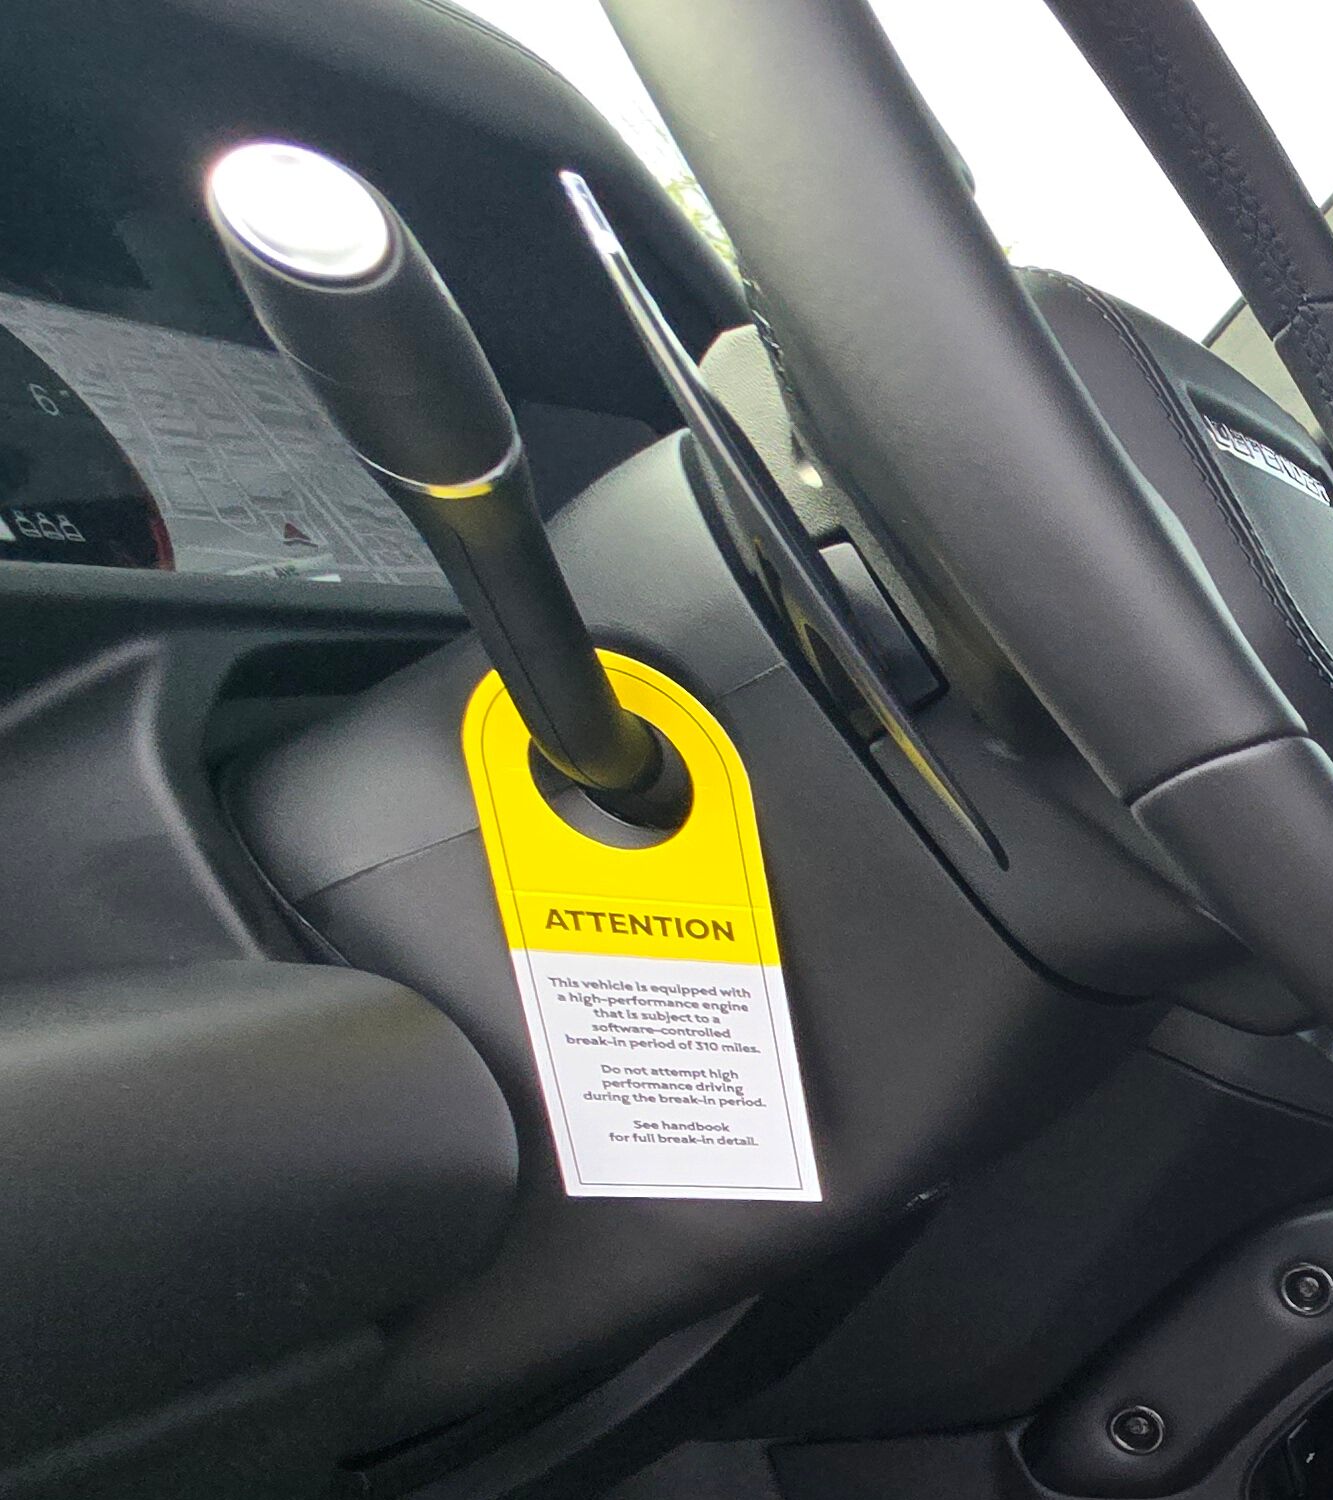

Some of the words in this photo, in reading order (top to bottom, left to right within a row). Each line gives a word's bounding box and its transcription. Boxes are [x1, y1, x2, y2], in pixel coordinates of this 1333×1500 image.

[28, 383, 60, 416] 6
[546, 909, 735, 941] ATTENTION
[548, 977, 579, 988] This
[581, 980, 633, 991] vehicle
[637, 982, 648, 992] is
[651, 985, 716, 997] equipped
[720, 987, 751, 998] with
[569, 993, 699, 1010] high-performance
[702, 1001, 749, 1014] engine
[593, 1008, 624, 1019] that
[627, 1010, 638, 1019] is
[642, 1011, 690, 1024] subject
[694, 1015, 710, 1024] to
[712, 1016, 720, 1024] a
[592, 1022, 731, 1038] software-controlled
[566, 1034, 626, 1047] break-in
[631, 1038, 675, 1050] period
[679, 1040, 693, 1050] of
[696, 1041, 719, 1051] 310
[722, 1043, 761, 1054] miles.
[601, 1065, 620, 1074] Do
[624, 1067, 648, 1076] not
[651, 1068, 707, 1079] attempt
[710, 1069, 739, 1082] high
[602, 1079, 693, 1091] performance
[696, 1083, 744, 1096] driving
[583, 1092, 630, 1105] during
[633, 1093, 656, 1103] the
[659, 1094, 716, 1105] break-in
[720, 1097, 766, 1108] period.
[634, 1120, 658, 1130] See
[662, 1121, 730, 1132] handbook
[609, 1132, 629, 1142] for
[633, 1133, 655, 1143] full
[659, 1134, 714, 1144] break-in
[717, 1137, 758, 1146] detail.
